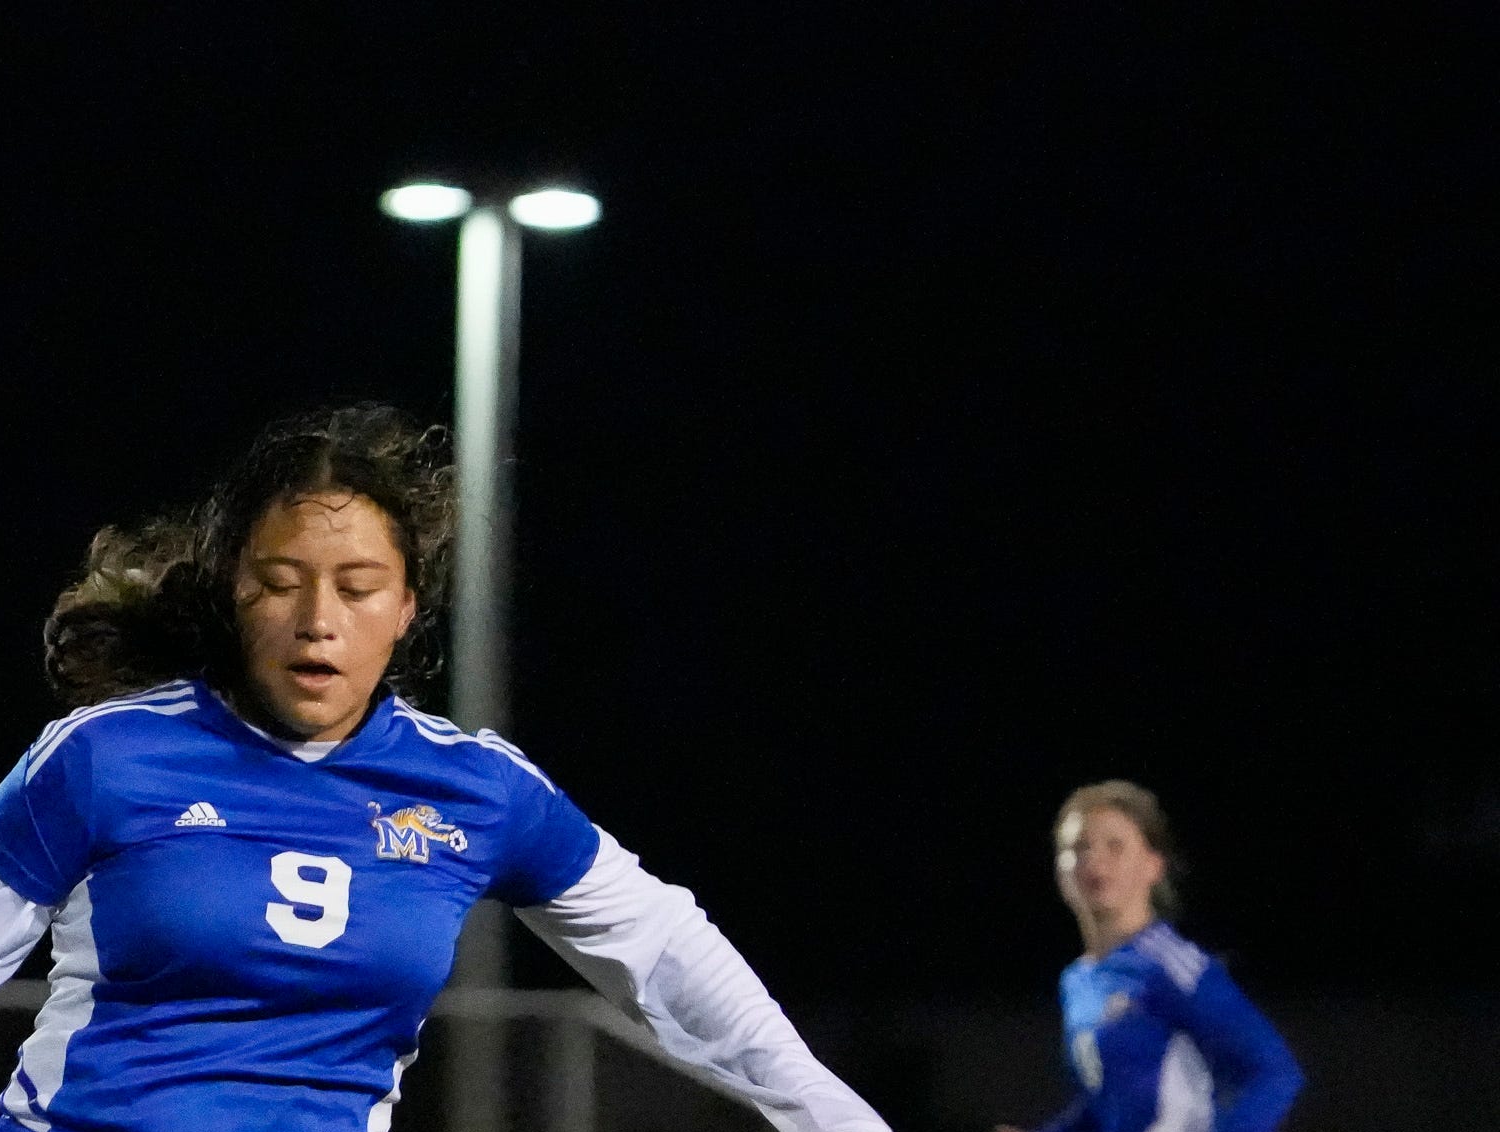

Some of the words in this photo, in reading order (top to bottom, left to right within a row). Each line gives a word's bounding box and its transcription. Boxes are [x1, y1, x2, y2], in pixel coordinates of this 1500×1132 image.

[174, 816, 227, 827] adidas
[377, 817, 430, 864] M
[265, 851, 352, 949] 9
